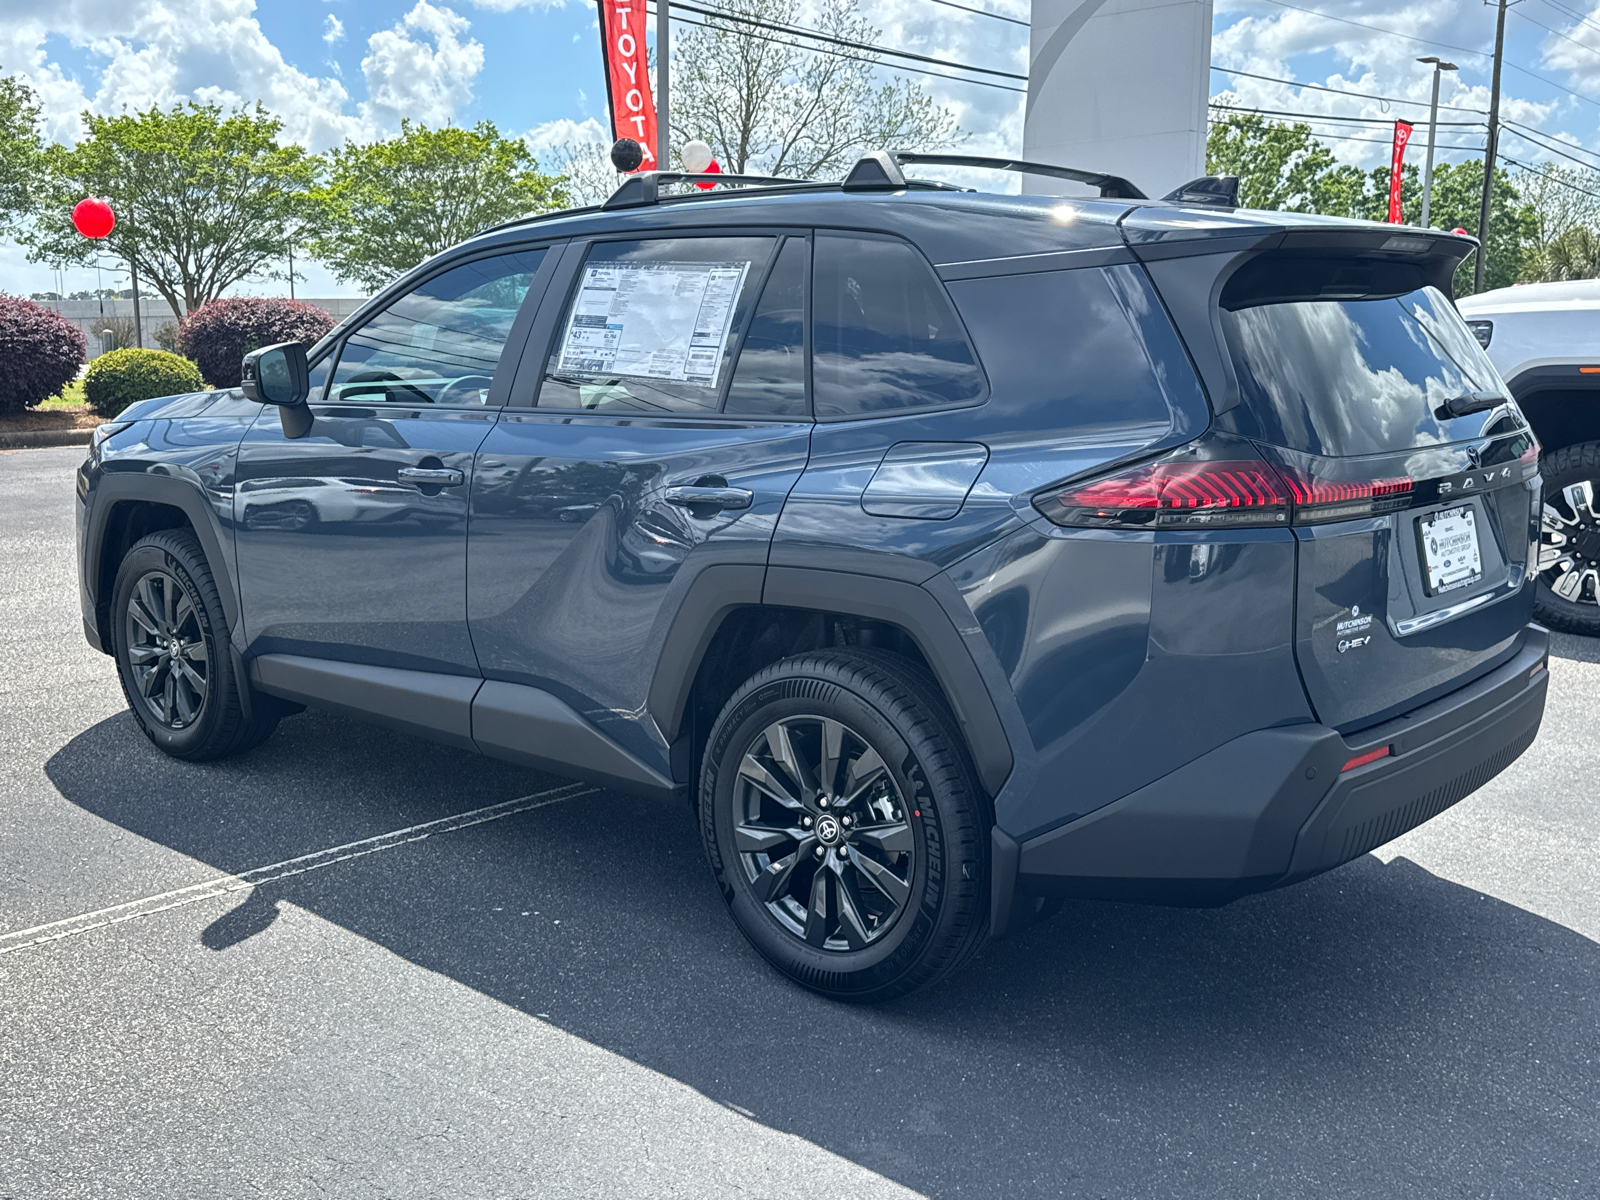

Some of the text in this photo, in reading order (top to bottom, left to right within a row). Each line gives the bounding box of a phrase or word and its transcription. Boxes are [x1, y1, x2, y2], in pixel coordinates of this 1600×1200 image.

[1437, 467, 1511, 494] RAV4
[176, 567, 209, 628] MICHELIN
[1337, 615, 1372, 631] HUTCHINSON
[703, 767, 721, 869] MICHELIN
[917, 796, 942, 909] MICHELIN
